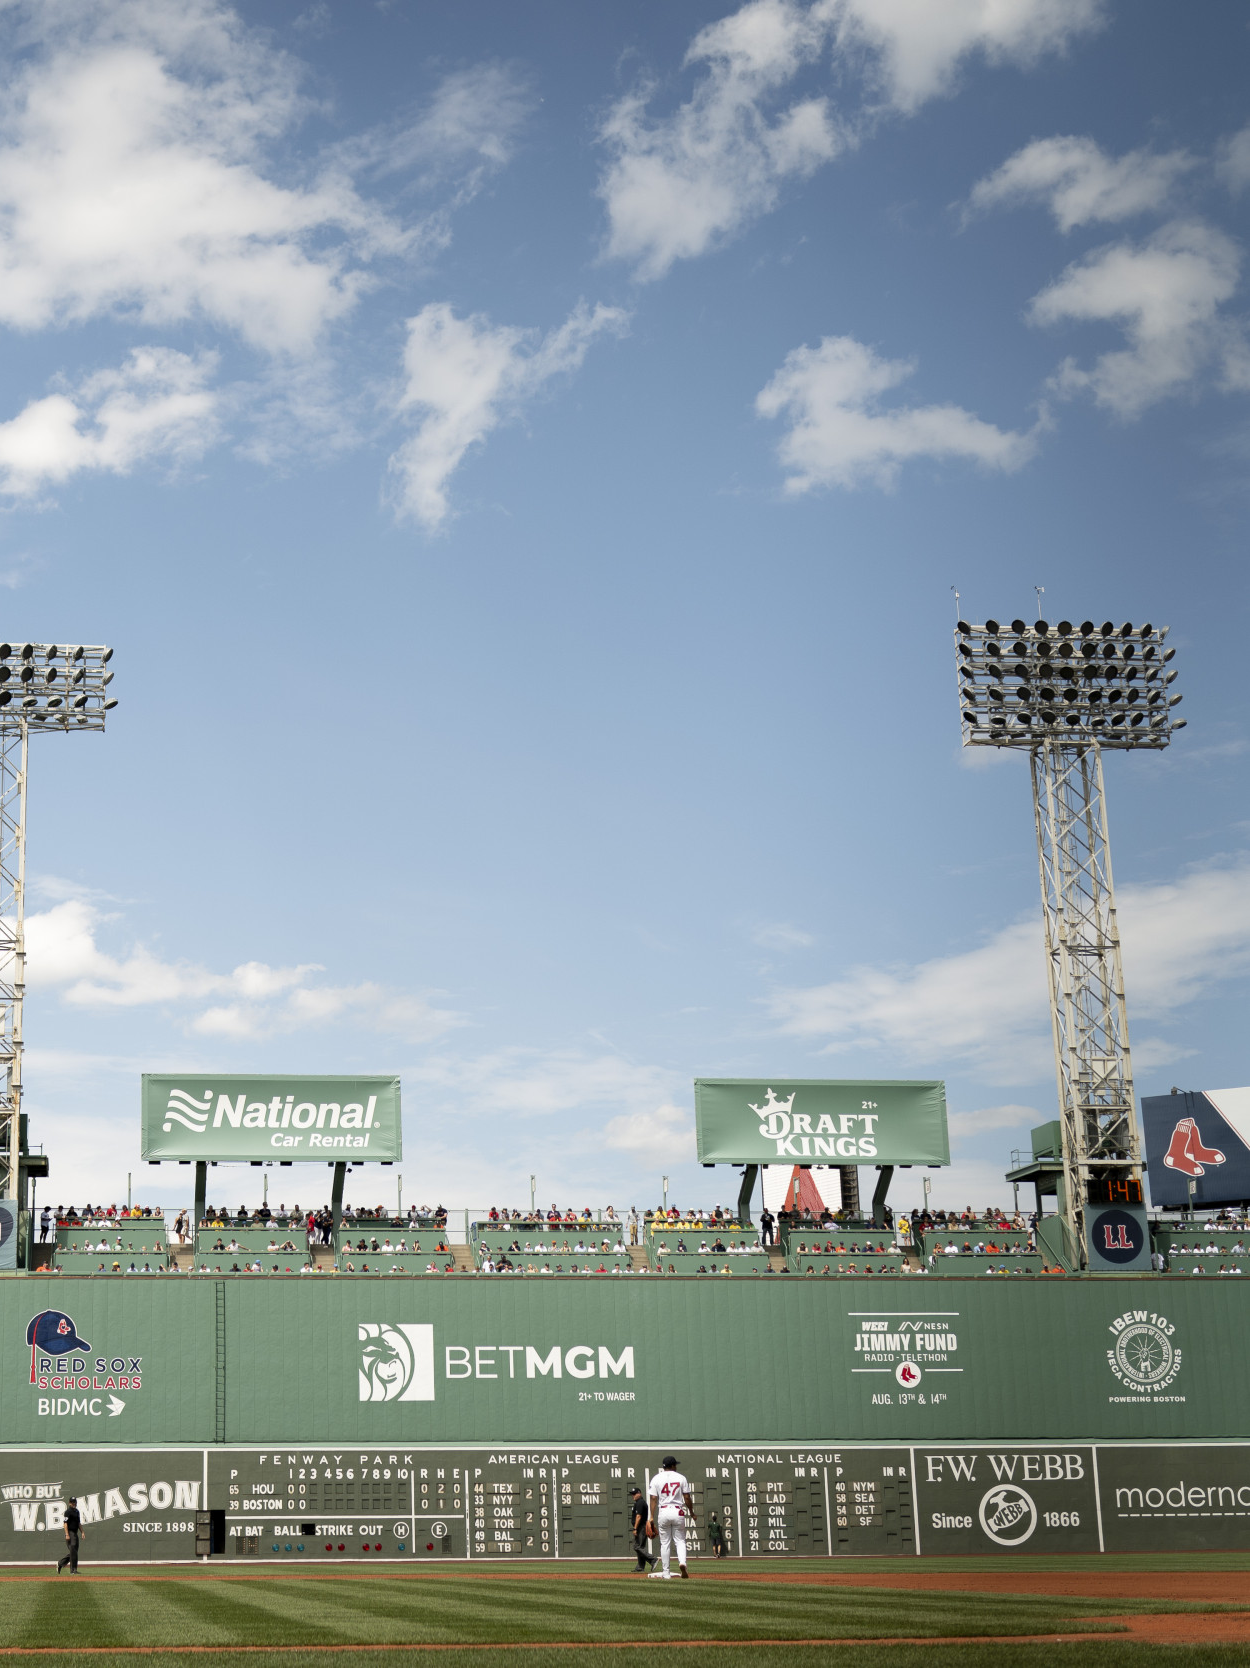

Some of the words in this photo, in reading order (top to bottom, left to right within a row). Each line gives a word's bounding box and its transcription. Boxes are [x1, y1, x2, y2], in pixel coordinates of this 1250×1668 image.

[862, 1101, 878, 1110] 21+
[212, 1094, 378, 1129] National
[270, 1133, 303, 1148] Car
[308, 1133, 370, 1148] Rental
[776, 1135, 878, 1157] KINGS
[1108, 1179, 1142, 1202] 1:47
[1108, 1311, 1148, 1336] IBEW
[1150, 1313, 1176, 1336] 103
[854, 1334, 911, 1351] JIMMY
[915, 1334, 958, 1351] FUND
[39, 1357, 86, 1373] RED
[94, 1357, 143, 1373] SOX
[445, 1345, 635, 1379] BETMGM
[1106, 1350, 1123, 1380] NECA
[1123, 1349, 1182, 1393] CONTRACTORS
[38, 1376, 142, 1390] SCHOLARS
[578, 1392, 592, 1401] 21+
[594, 1392, 605, 1401] TO
[606, 1392, 635, 1401] WAGER
[872, 1393, 894, 1405] AUG.
[918, 1393, 926, 1405] &
[38, 1398, 102, 1416] BIDMC
[259, 1455, 343, 1465] FENWAY
[360, 1455, 413, 1465] PARK
[488, 1455, 559, 1464] AMERICAN
[566, 1454, 619, 1464] LEAGUE
[717, 1454, 784, 1464] NATIONAL
[789, 1454, 842, 1463] LEAGUE
[987, 1453, 1084, 1481] WEBB
[252, 1484, 275, 1494] HOU
[493, 1484, 513, 1493] TEX
[580, 1484, 600, 1493] CLE
[661, 1482, 681, 1496] 47
[767, 1482, 784, 1491] PIT
[853, 1482, 875, 1491] NYM
[1, 1485, 34, 1500] WHO
[35, 1484, 62, 1499] BUT
[76, 1480, 201, 1525] MASON
[493, 1496, 513, 1505] NYY
[581, 1496, 600, 1505] MIN
[766, 1494, 786, 1503] LAD
[854, 1494, 875, 1503] SEA
[243, 1500, 283, 1510] BOSTON
[493, 1507, 513, 1517] OAK
[768, 1506, 785, 1515] CIN
[855, 1506, 876, 1515] DET
[494, 1519, 515, 1529] TOR
[768, 1518, 787, 1527] MIL
[859, 1517, 873, 1526] SF
[931, 1512, 973, 1528] Since
[1043, 1511, 1080, 1527] 1866
[123, 1522, 162, 1533] SINCE
[165, 1522, 194, 1533] 1898
[229, 1526, 243, 1536] AT
[245, 1526, 264, 1536] BAT
[274, 1526, 302, 1536] BALL
[315, 1525, 354, 1535] STRIKE
[359, 1525, 383, 1535] OUT
[494, 1531, 514, 1541] BAL
[769, 1530, 788, 1539] ATL
[498, 1543, 512, 1552] TB
[768, 1541, 789, 1550] COL
